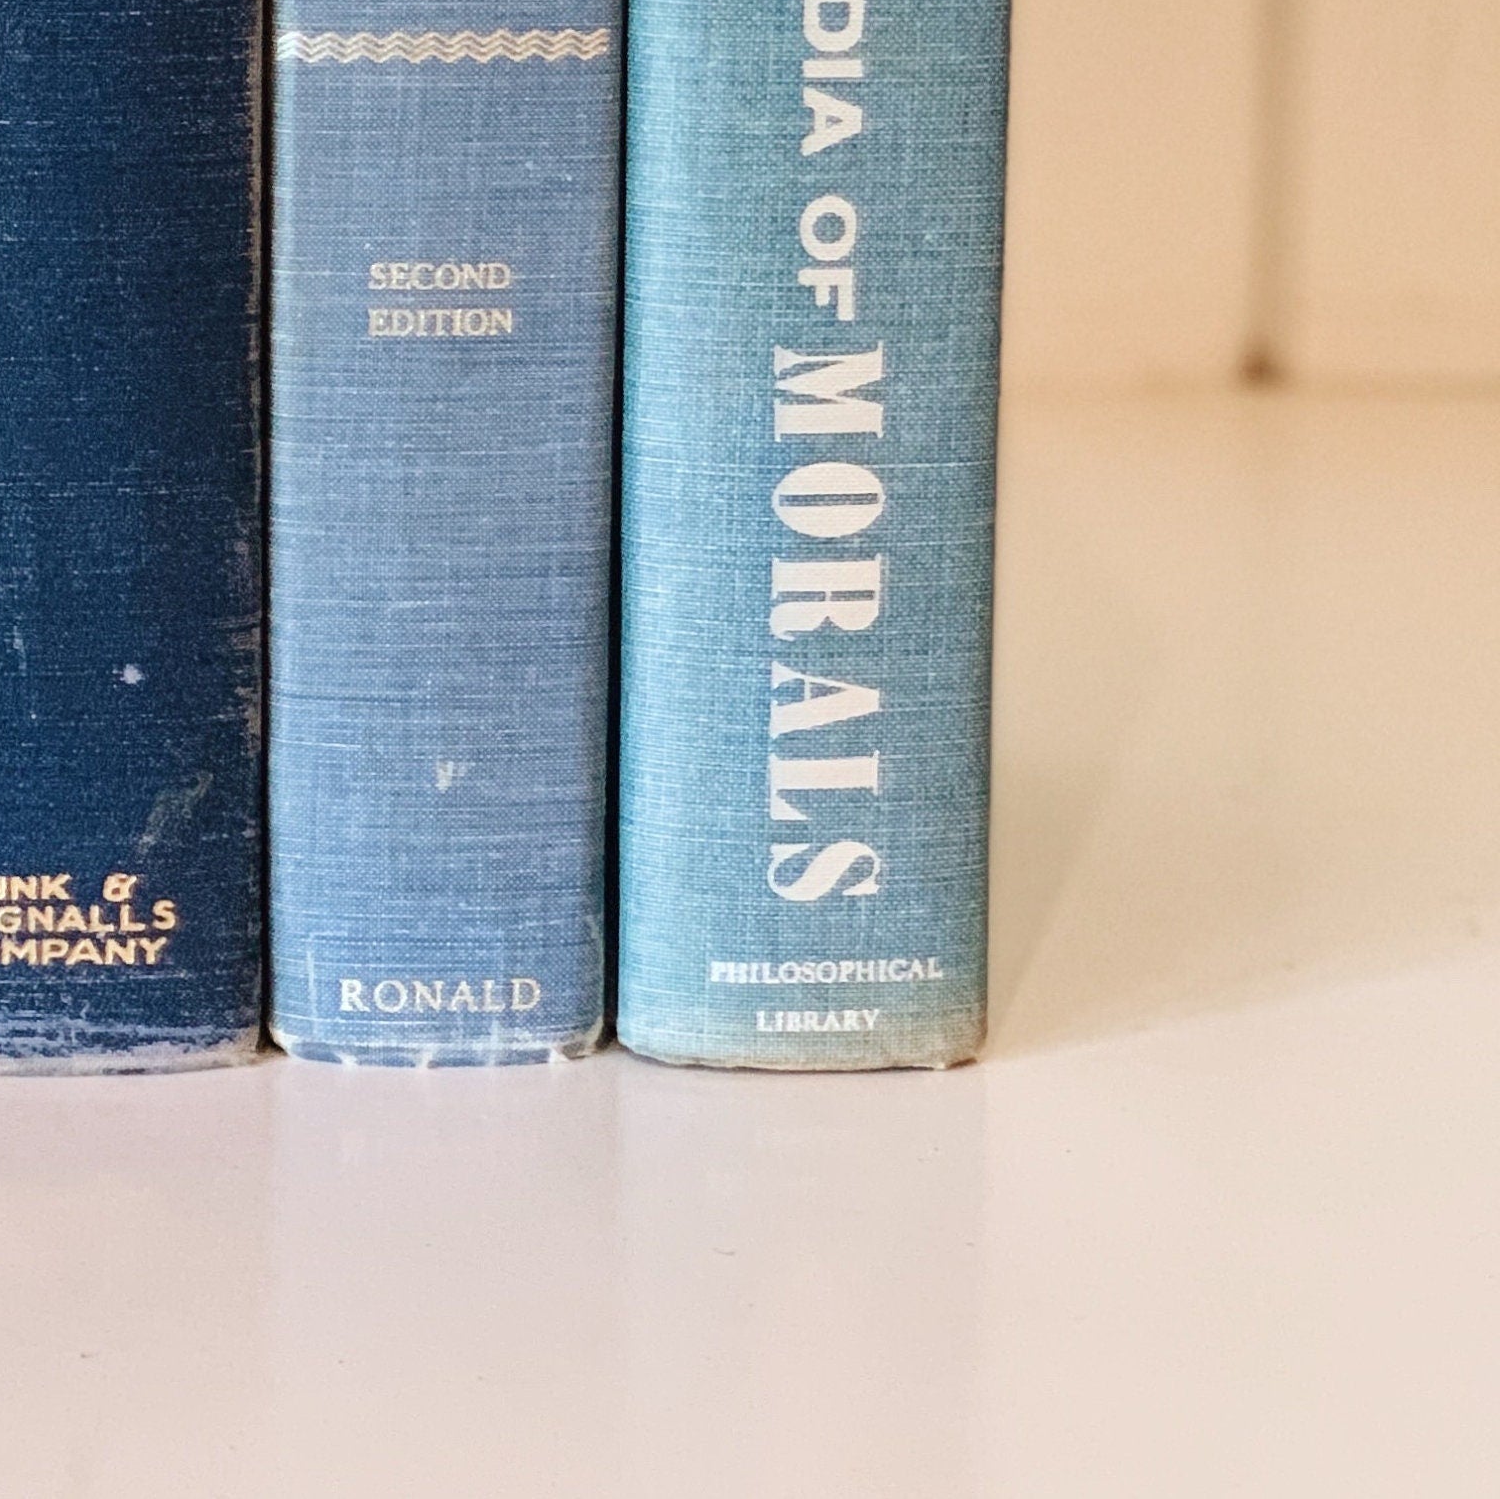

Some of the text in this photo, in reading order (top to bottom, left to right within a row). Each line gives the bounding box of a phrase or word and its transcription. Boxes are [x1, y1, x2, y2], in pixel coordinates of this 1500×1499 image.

[799, 195, 857, 321] OF
[368, 261, 512, 291] SECOND
[368, 307, 514, 338] EDITION
[766, 339, 887, 903] MORALS
[102, 872, 140, 902] &
[708, 959, 944, 985] PHILOSOPHICAL
[338, 976, 542, 1014] RONALD
[755, 1008, 882, 1034] LIBRARY
